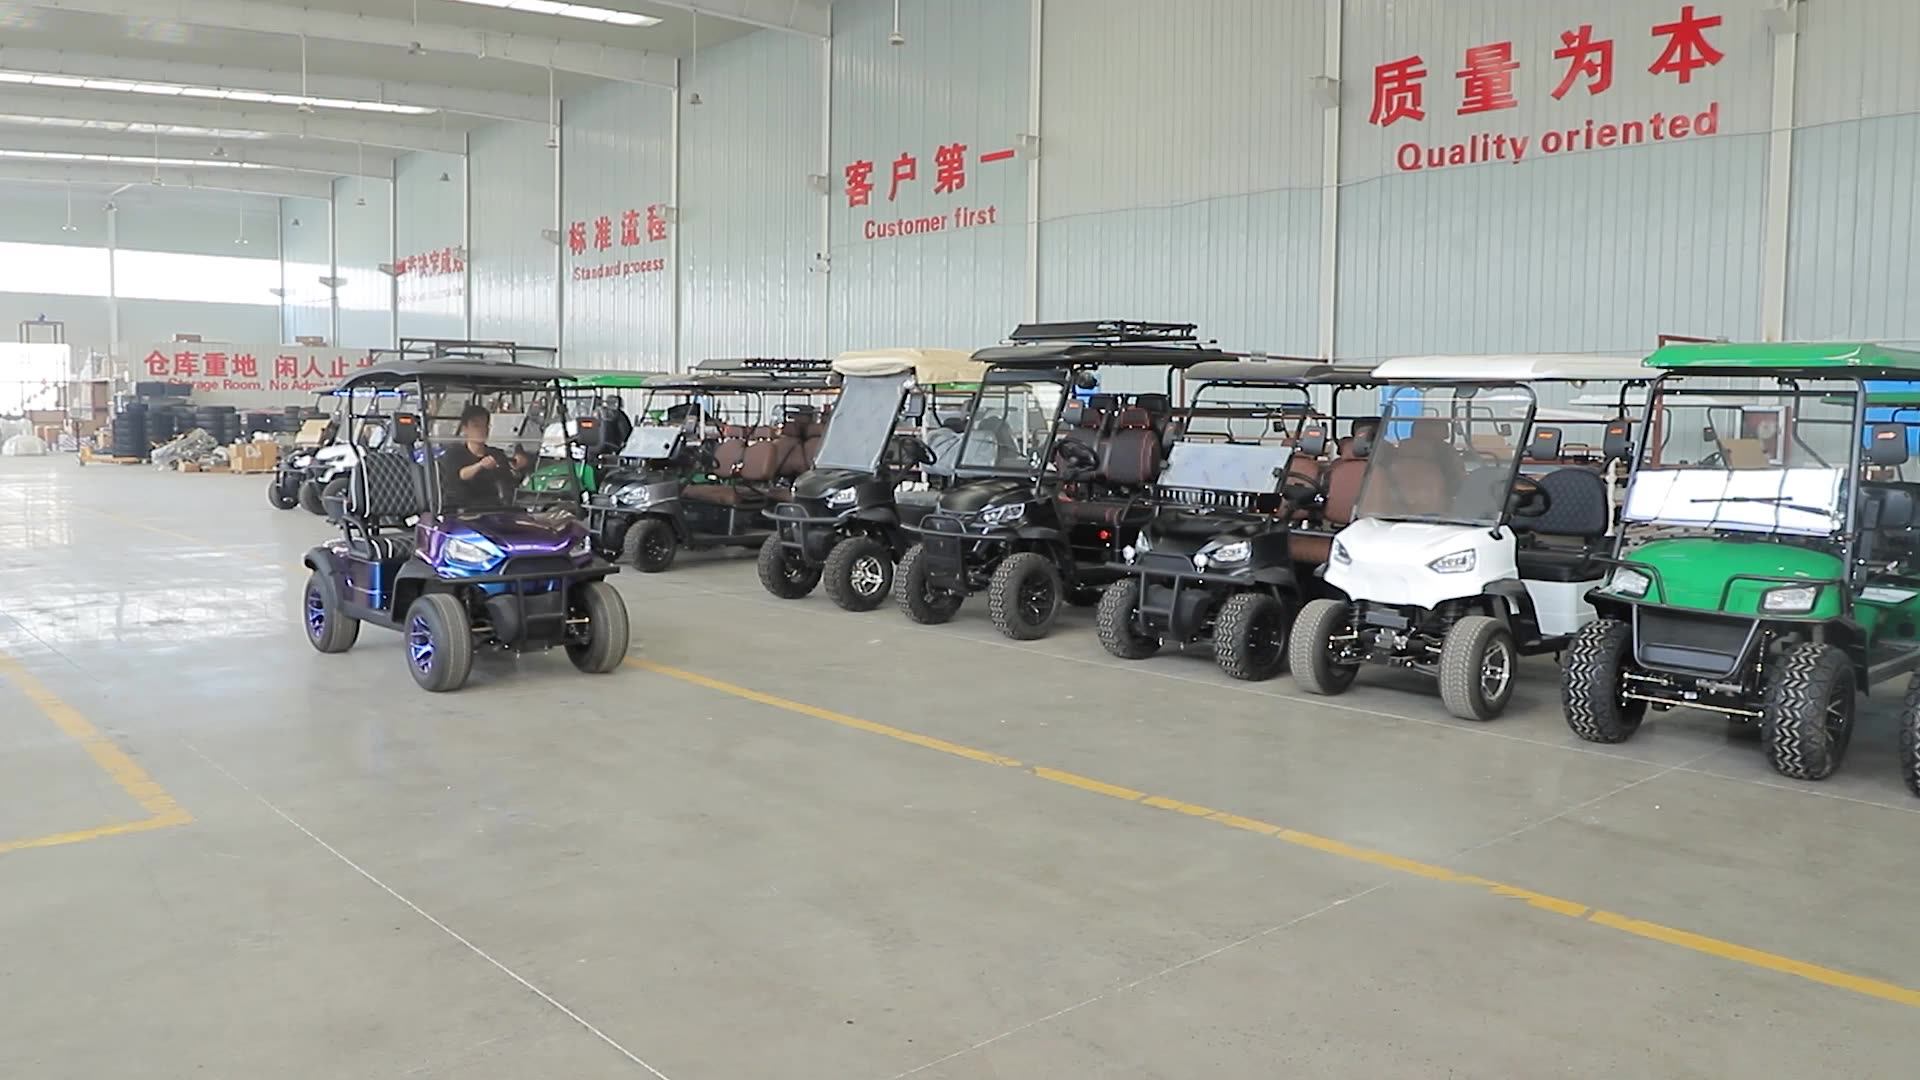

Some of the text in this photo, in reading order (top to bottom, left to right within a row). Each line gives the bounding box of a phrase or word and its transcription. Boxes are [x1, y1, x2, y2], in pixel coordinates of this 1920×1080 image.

[1369, 5, 1725, 127] 质量为本
[1397, 102, 1720, 171] Quality oriented
[845, 143, 1015, 208] 客户第一
[568, 204, 667, 256] 标准流程
[864, 205, 997, 239] Customer first
[574, 258, 665, 281] Standard process
[144, 350, 257, 377] 仓库重地
[270, 379, 289, 390] No
